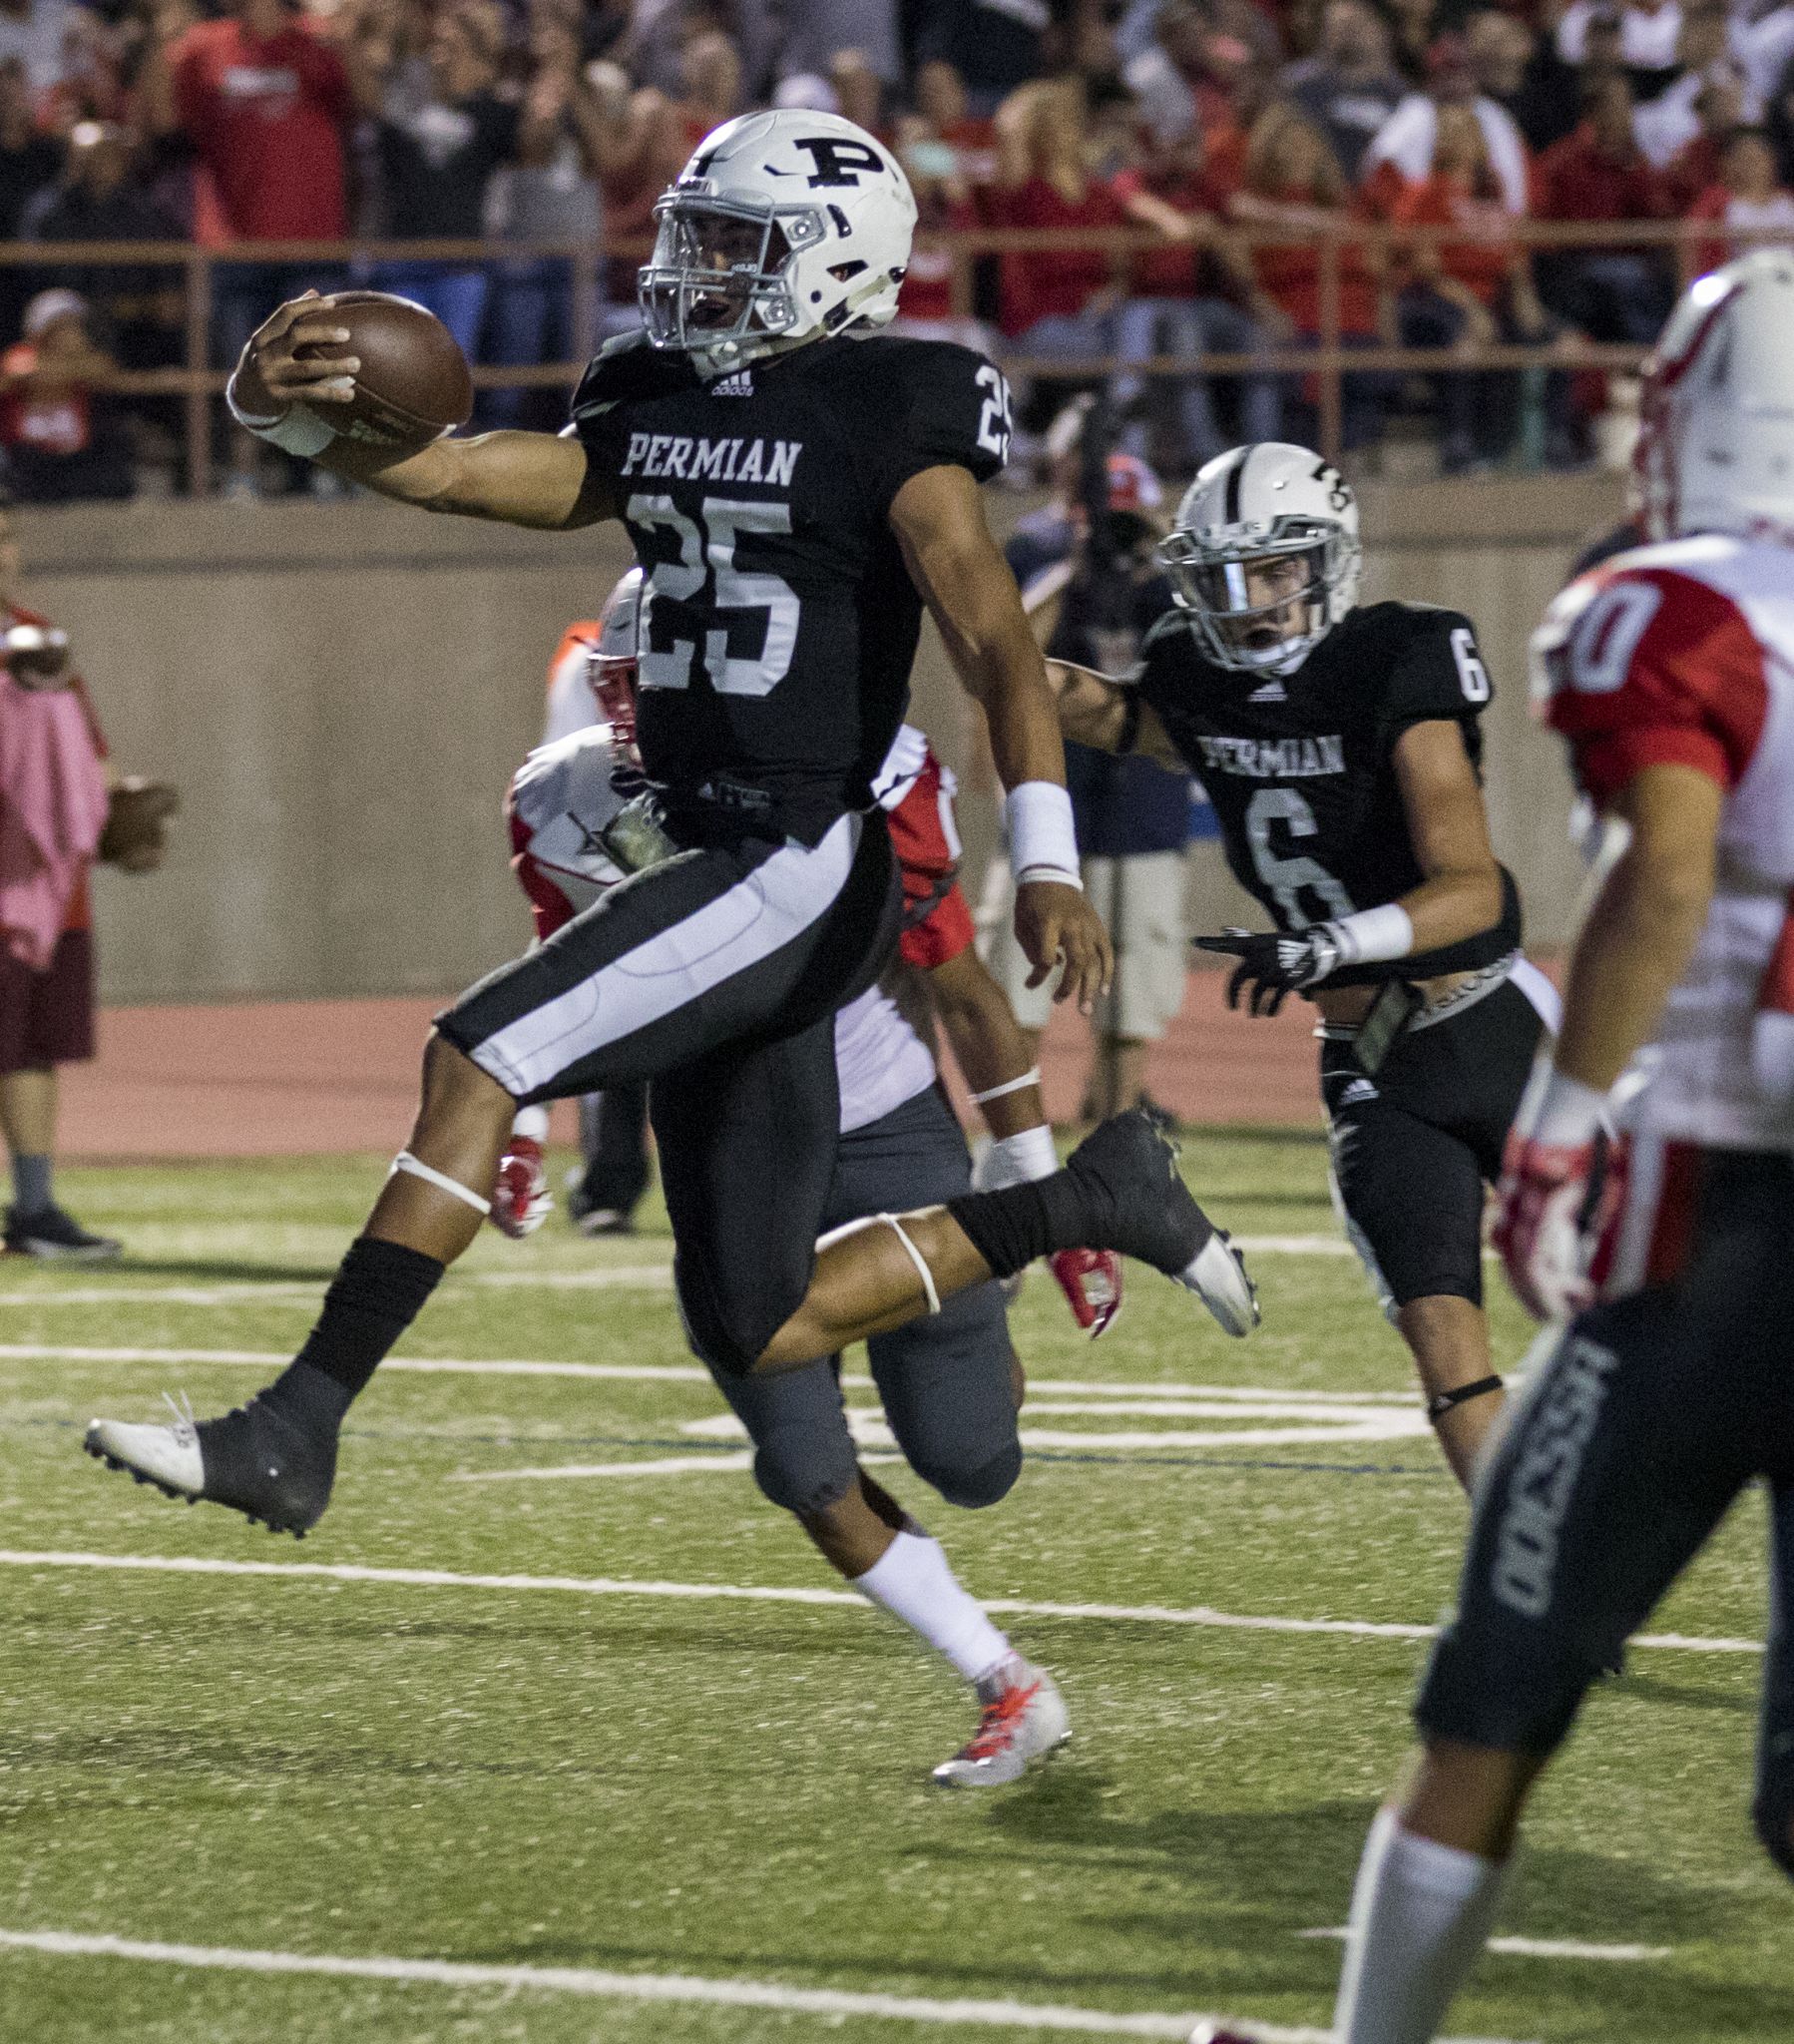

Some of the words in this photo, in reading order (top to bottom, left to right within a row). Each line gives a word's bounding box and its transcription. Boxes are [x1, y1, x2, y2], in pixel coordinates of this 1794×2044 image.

[794, 138, 883, 188] P
[620, 432, 802, 487] PERMIAN
[626, 494, 800, 697] 25
[1450, 629, 1490, 702] 6
[1196, 735, 1347, 776] PERMIAN
[1245, 788, 1357, 930] 6
